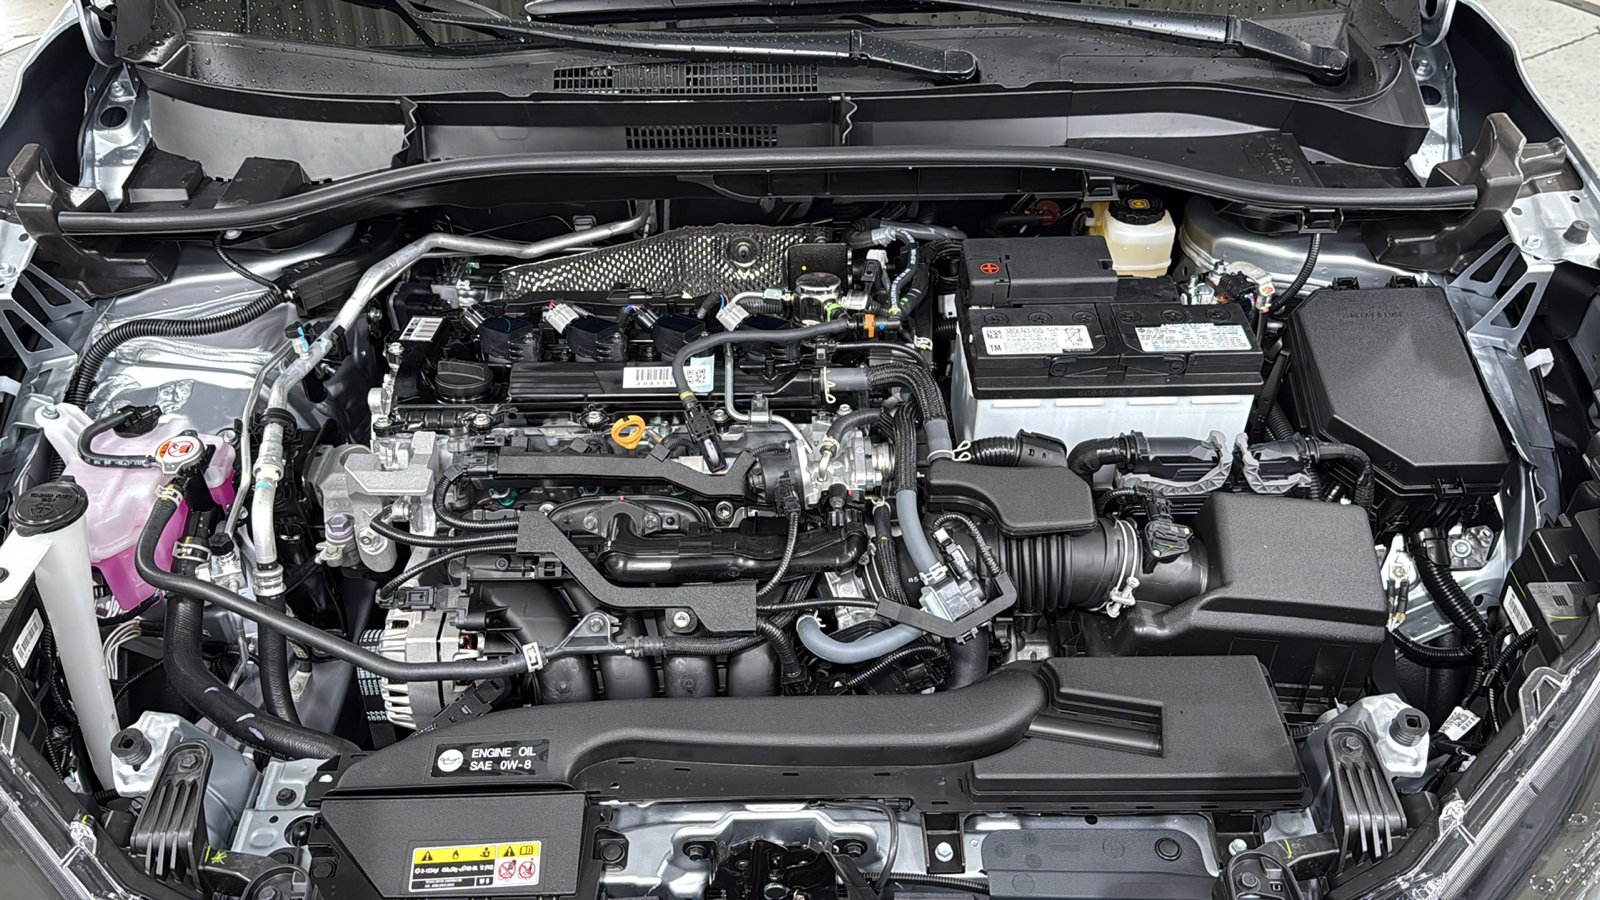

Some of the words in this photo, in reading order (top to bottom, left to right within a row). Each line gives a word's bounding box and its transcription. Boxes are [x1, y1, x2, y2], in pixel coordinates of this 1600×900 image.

[990, 344, 1001, 352] TM
[1385, 461, 1399, 473] A3
[471, 747, 512, 758] ENGINE
[518, 746, 536, 757] OIL
[469, 761, 493, 771] SAE
[500, 759, 532, 770] 0W-8
